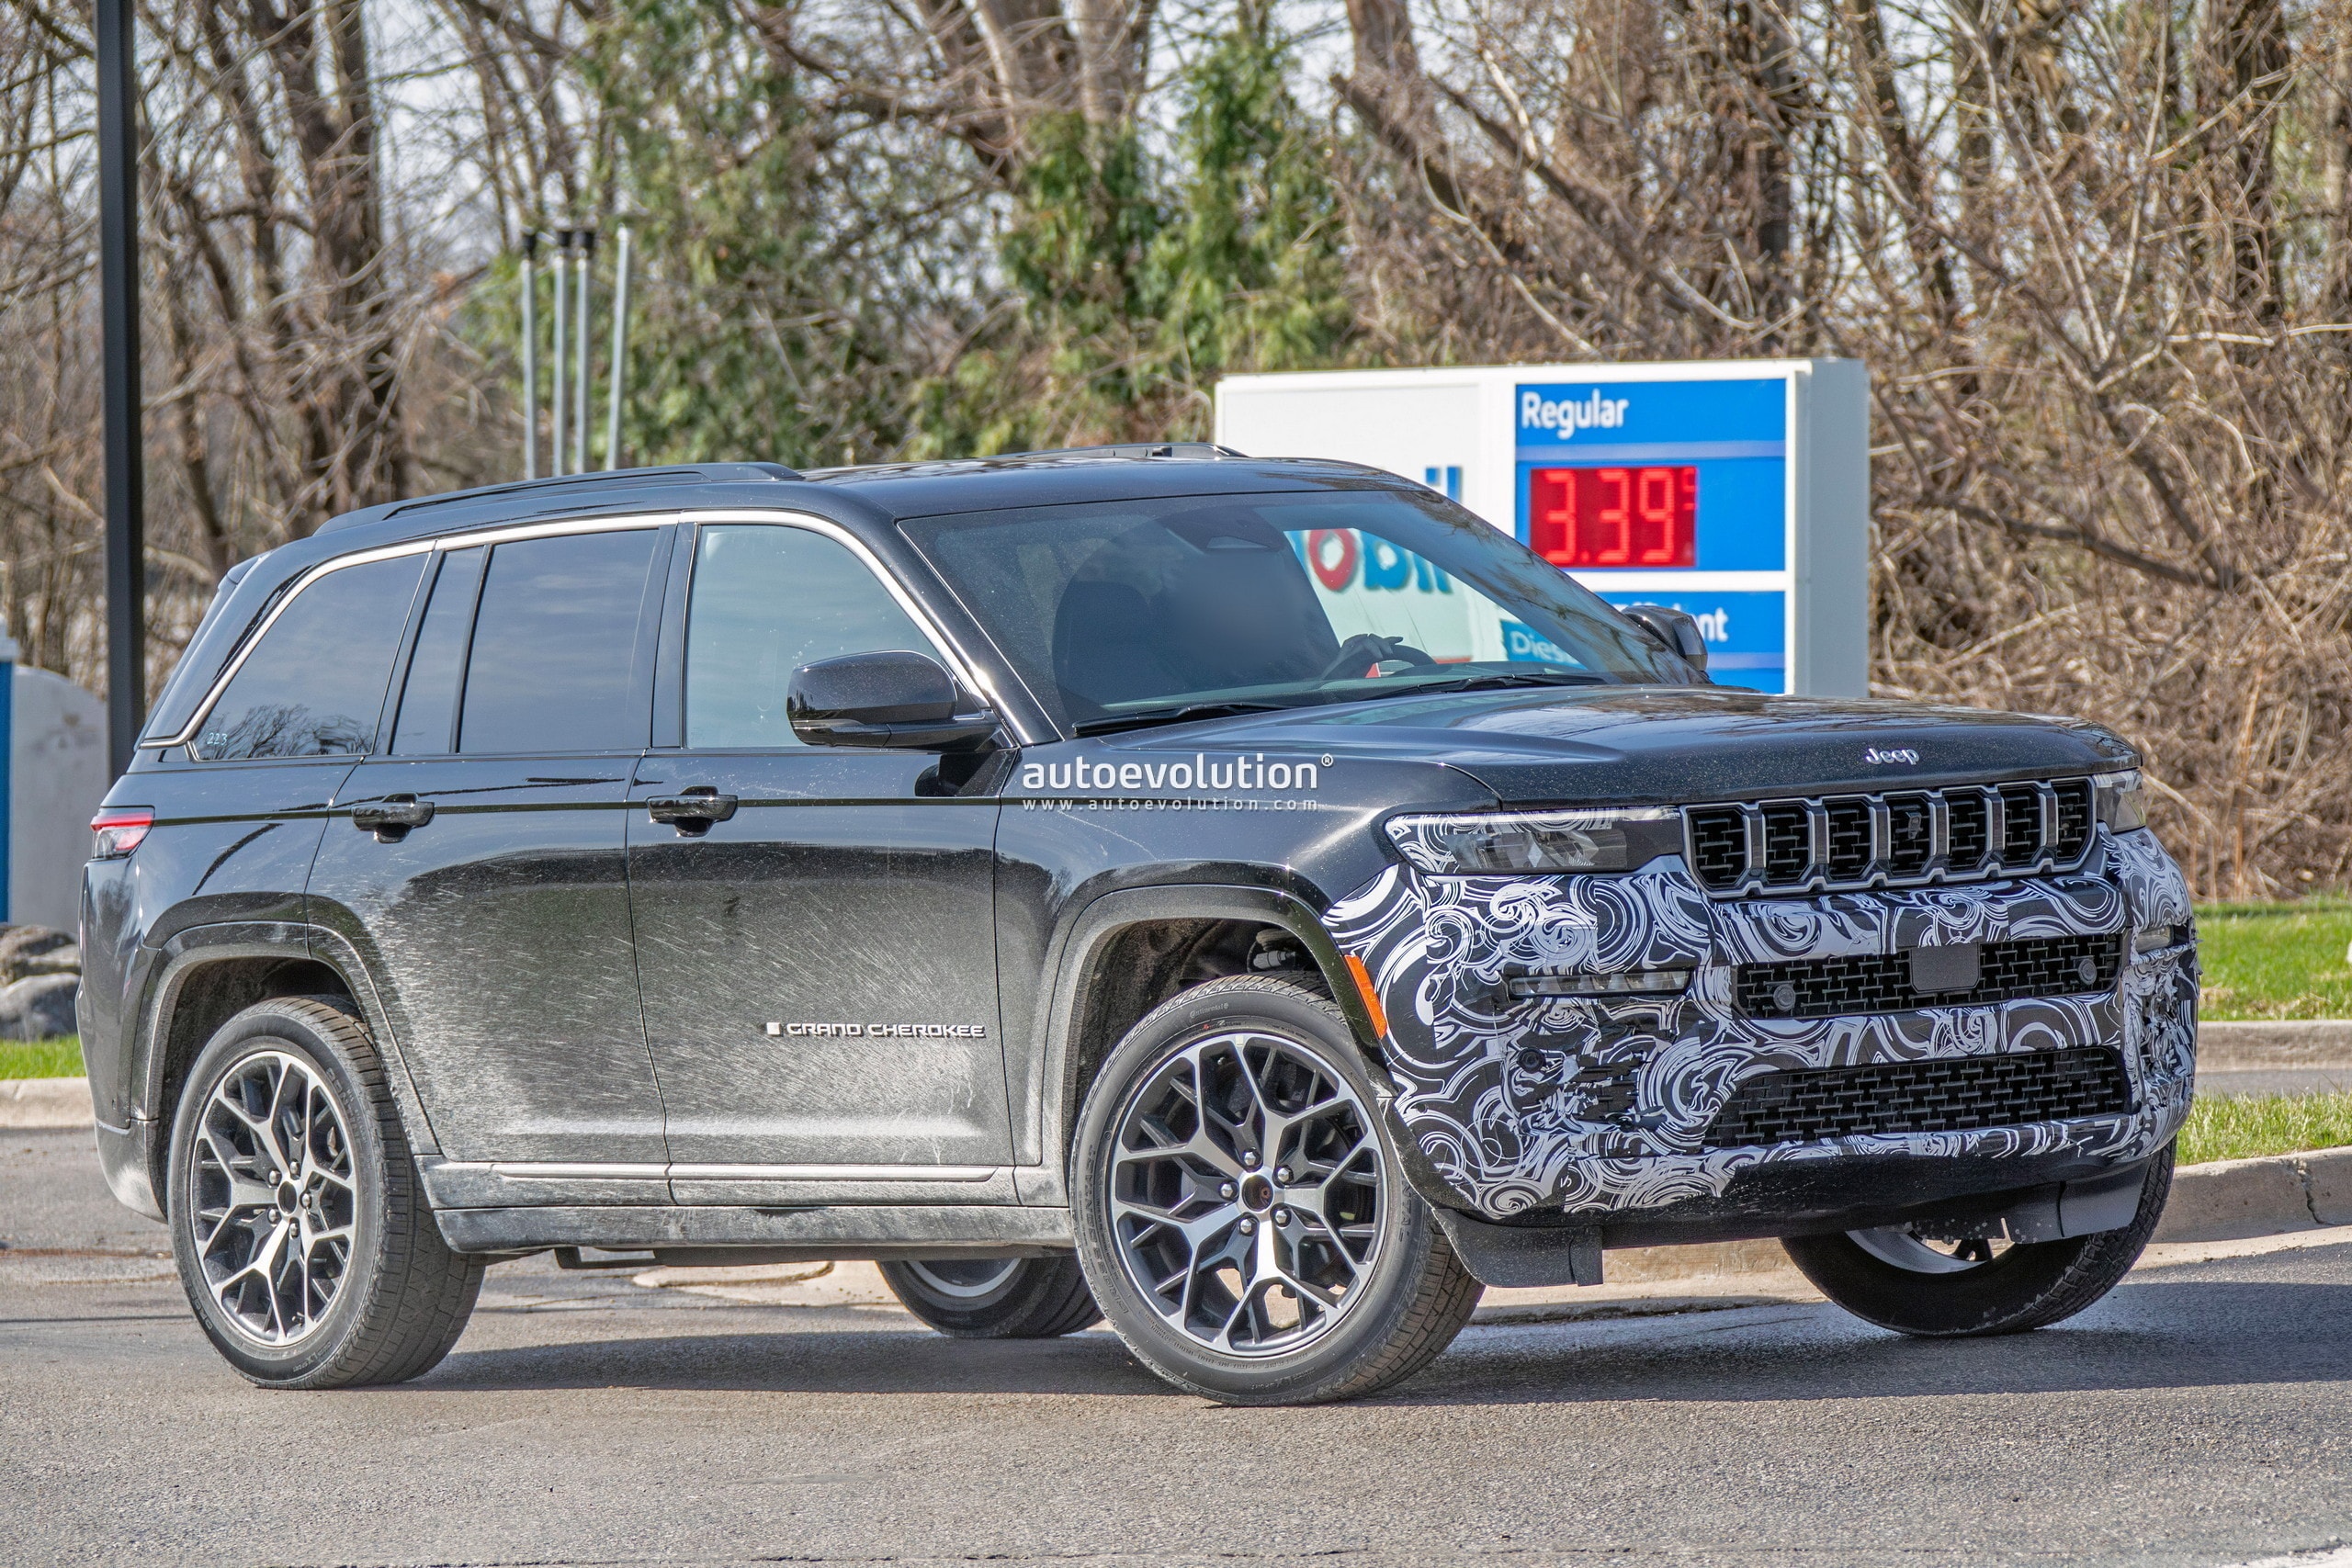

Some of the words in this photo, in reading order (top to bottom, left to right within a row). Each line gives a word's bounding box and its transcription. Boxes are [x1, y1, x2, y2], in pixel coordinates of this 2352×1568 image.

[1521, 388, 1629, 440] Regular
[207, 732, 228, 745] 223
[1866, 748, 1920, 765] Jeep
[786, 1022, 863, 1036] GRAND
[867, 1023, 986, 1038] CHEROKEE
